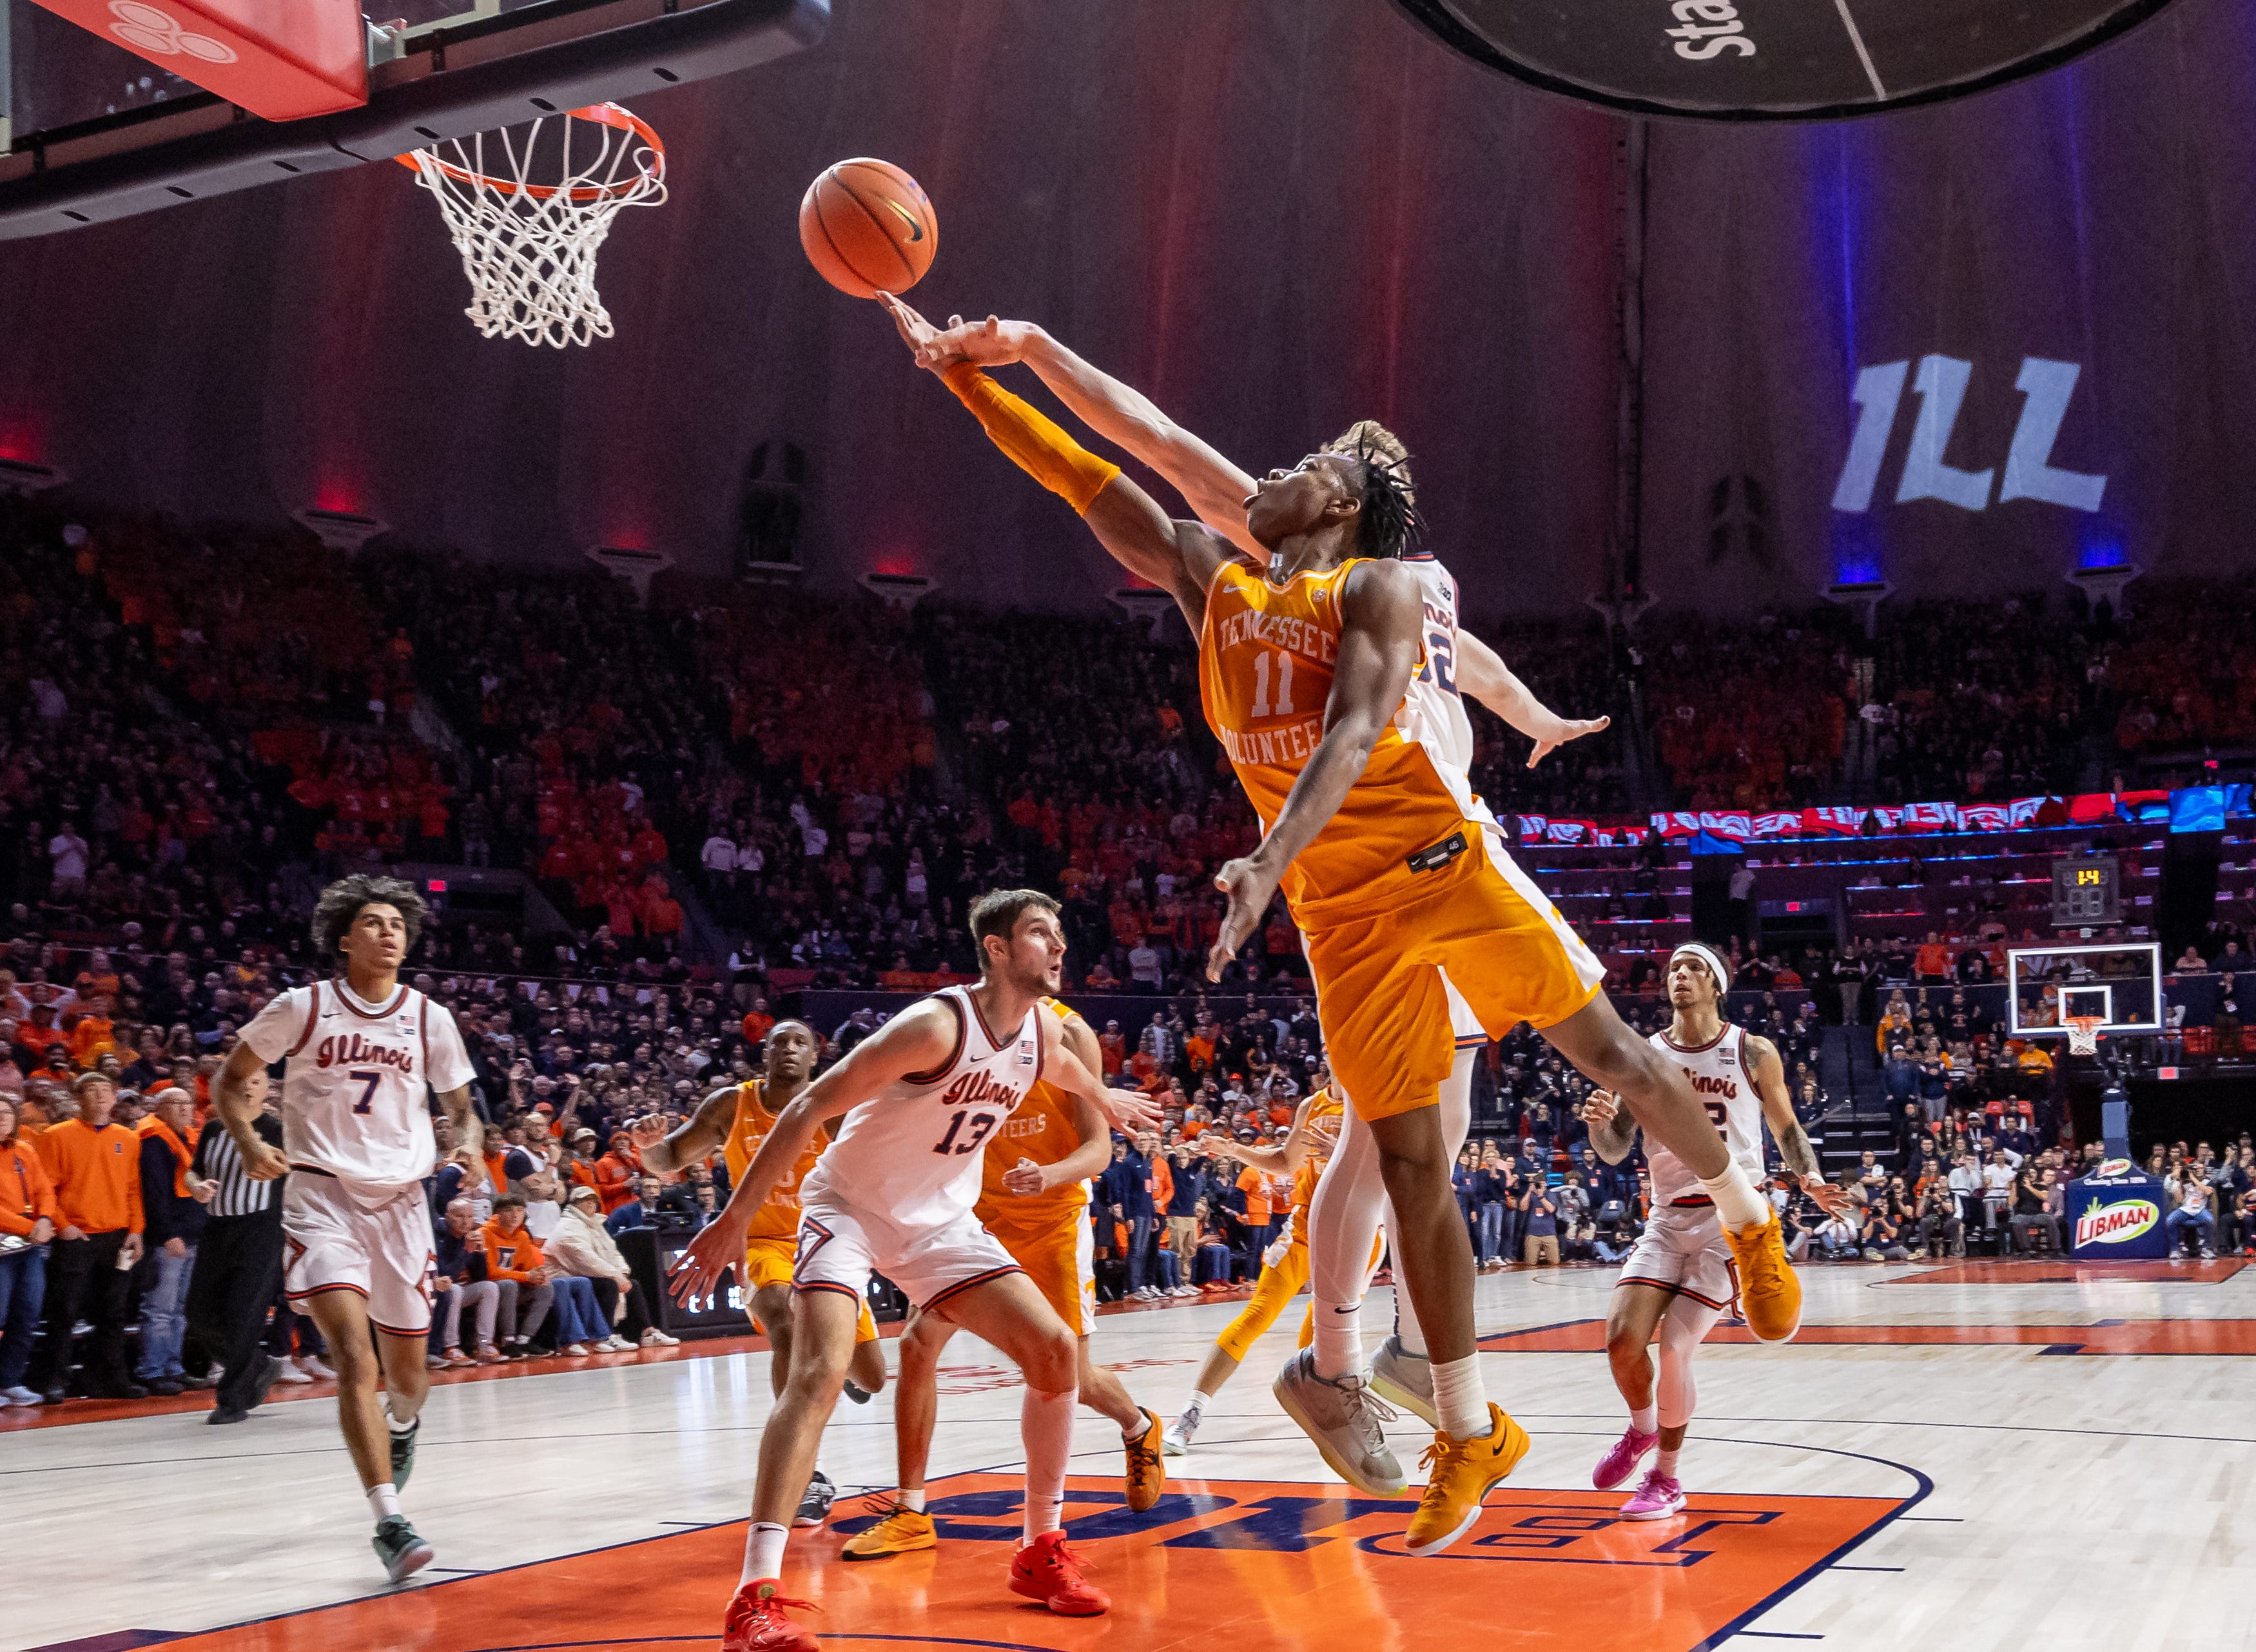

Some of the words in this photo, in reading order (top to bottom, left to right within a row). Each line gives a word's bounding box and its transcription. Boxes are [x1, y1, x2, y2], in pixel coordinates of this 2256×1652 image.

[1664, 0, 1756, 61] Sta
[1830, 353, 2108, 514] ILL
[1220, 608, 1335, 665] TENNESSEE
[1251, 650, 1294, 717] 11
[2078, 870, 2100, 886] 14
[316, 1033, 413, 1074] Illinois
[349, 1070, 381, 1114] 7
[942, 1067, 1021, 1111] Illinois
[933, 1110, 996, 1156] 13
[999, 1113, 1047, 1138] TEERS
[2079, 1207, 2151, 1245] LIBMAN
